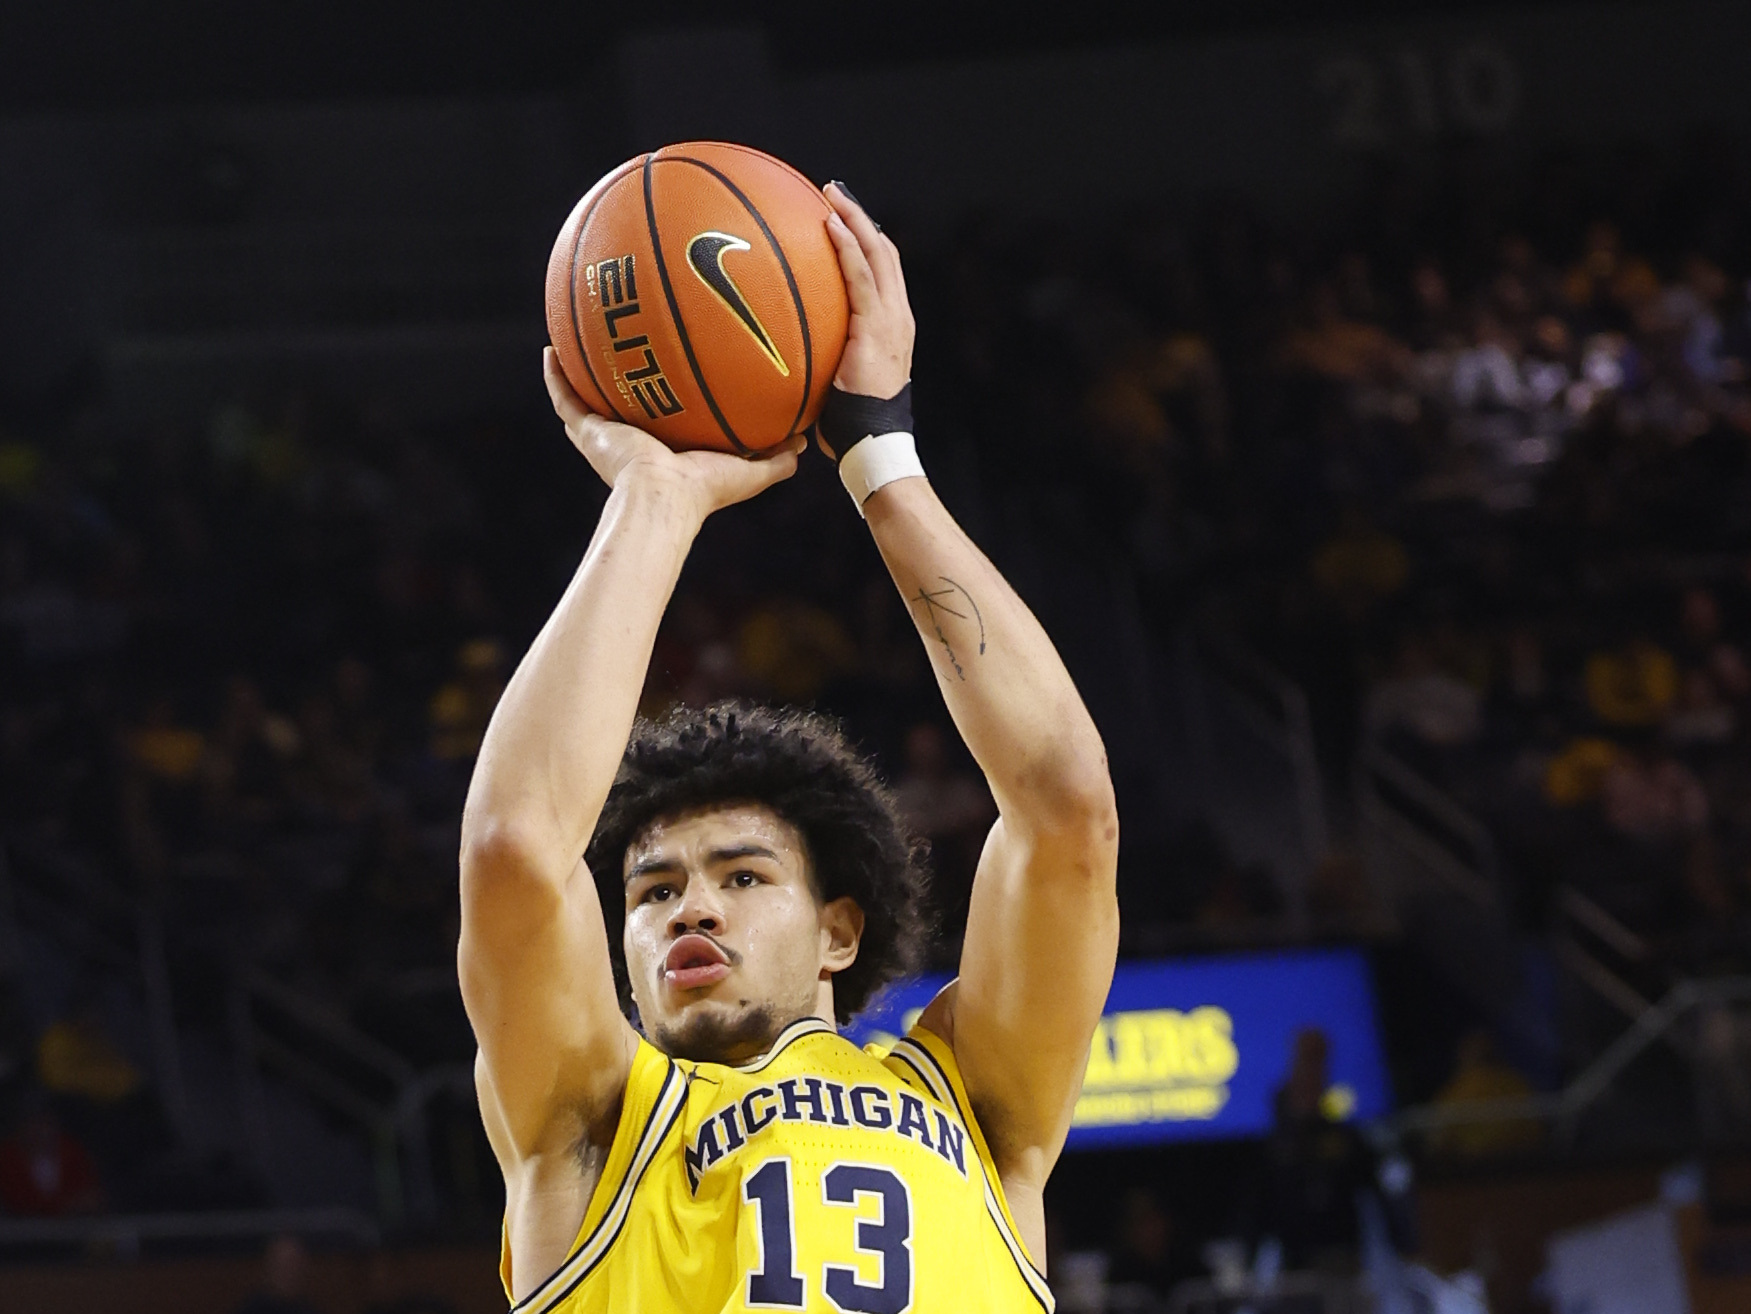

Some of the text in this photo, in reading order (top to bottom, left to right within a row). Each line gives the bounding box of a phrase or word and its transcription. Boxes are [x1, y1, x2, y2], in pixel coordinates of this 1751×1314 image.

[1313, 45, 1522, 145] 210
[598, 253, 684, 419] ELITE
[685, 1077, 968, 1198] MICHIGAN
